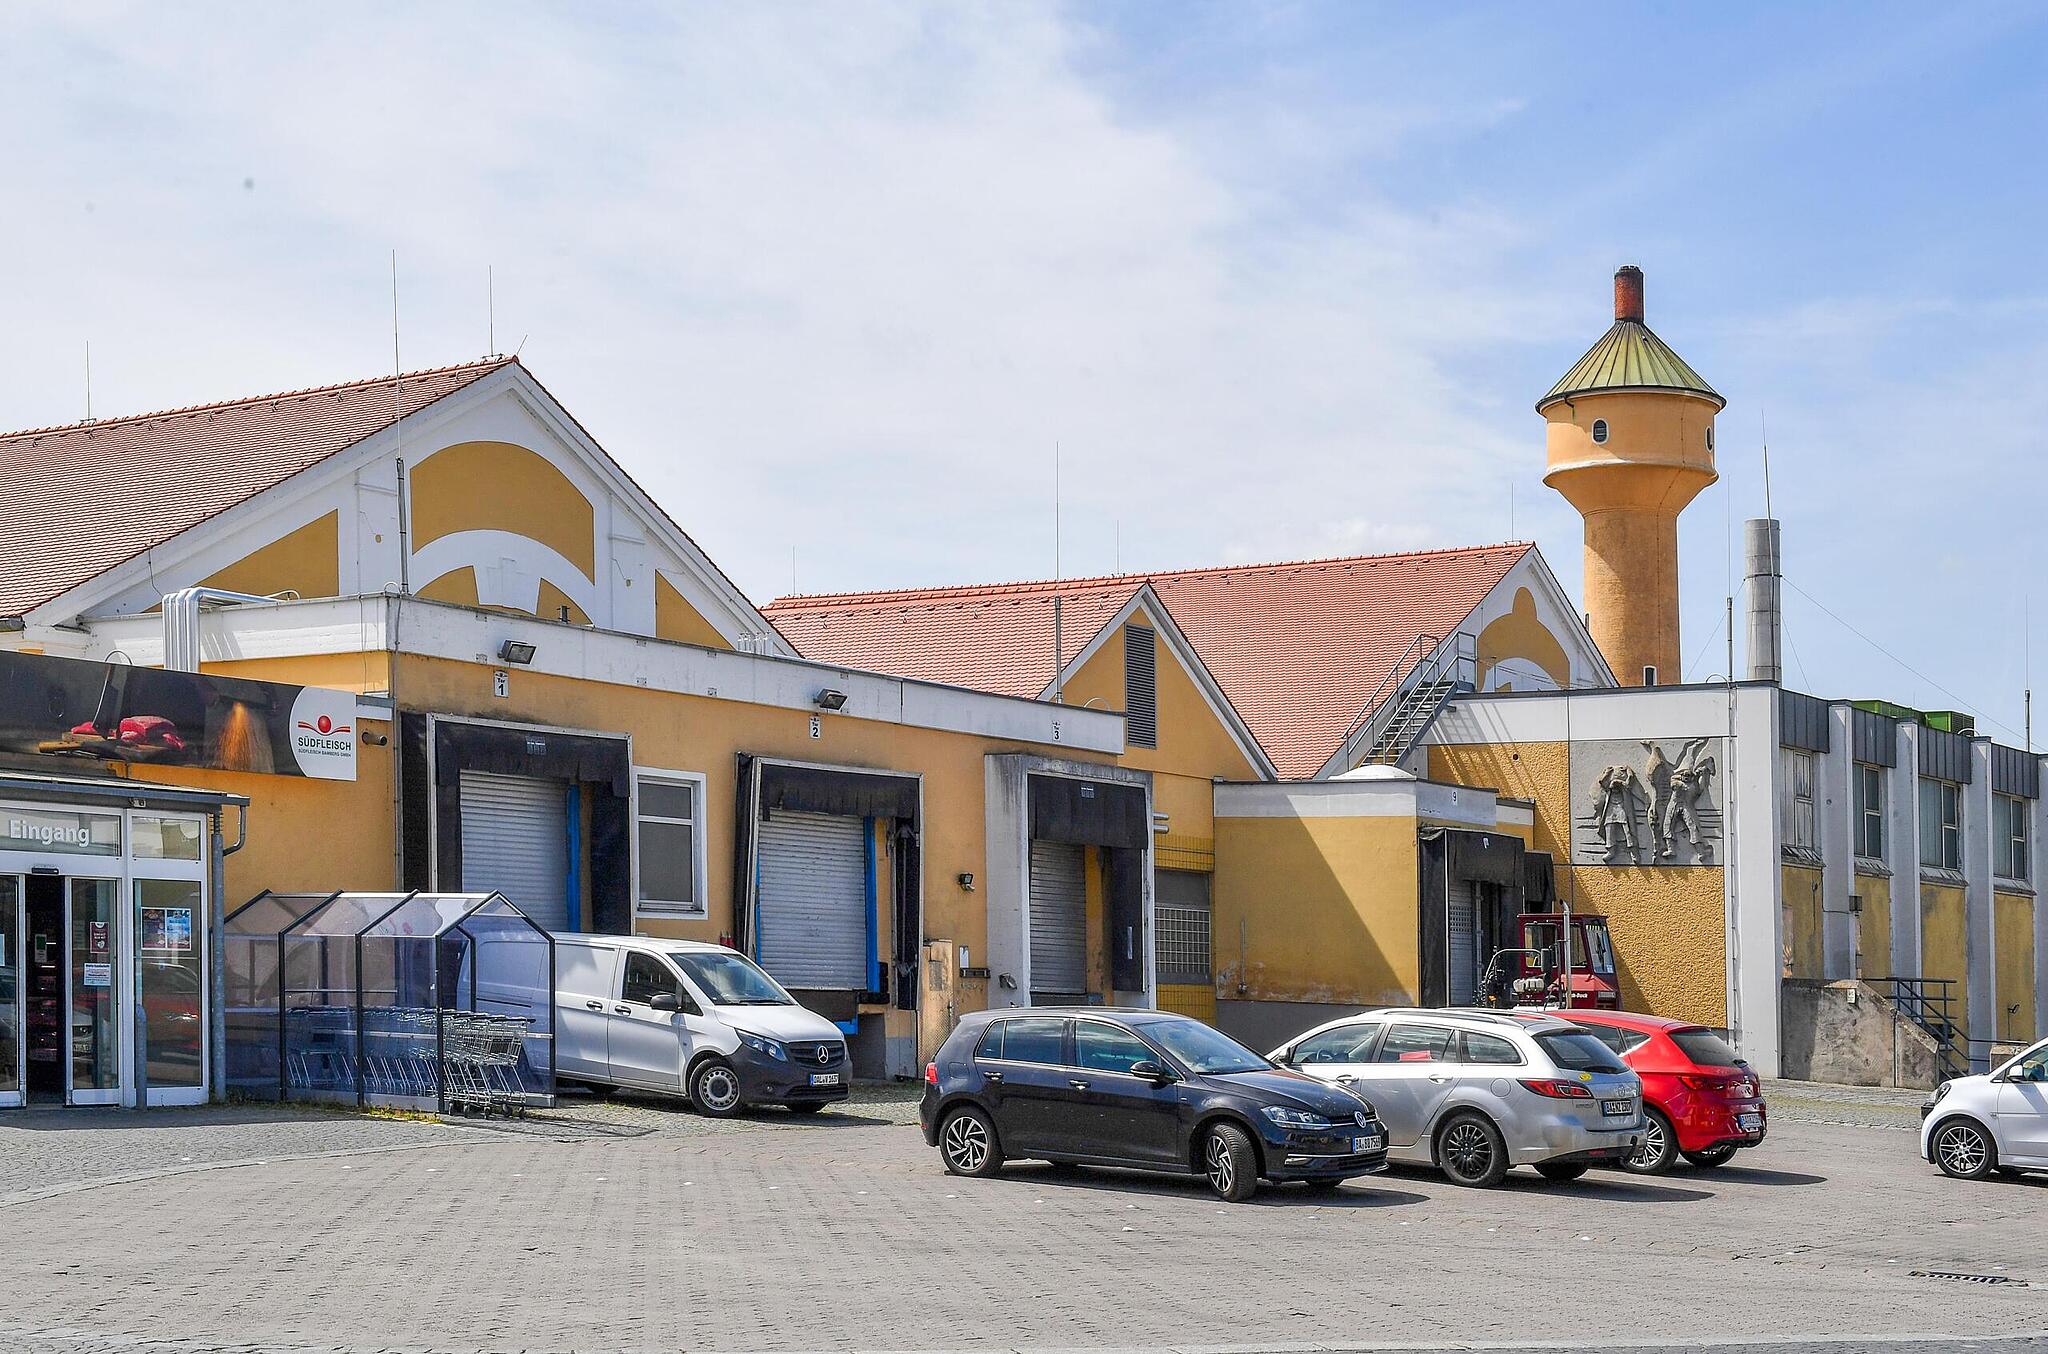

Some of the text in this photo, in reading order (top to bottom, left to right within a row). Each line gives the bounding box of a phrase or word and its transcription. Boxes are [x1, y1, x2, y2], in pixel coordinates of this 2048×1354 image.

[498, 684, 504, 695] 1
[812, 727, 819, 737] 2
[1054, 730, 1060, 740] 3
[298, 735, 351, 751] SÜDFLEISCH
[1452, 791, 1457, 802] 9
[10, 819, 89, 847] Eingang
